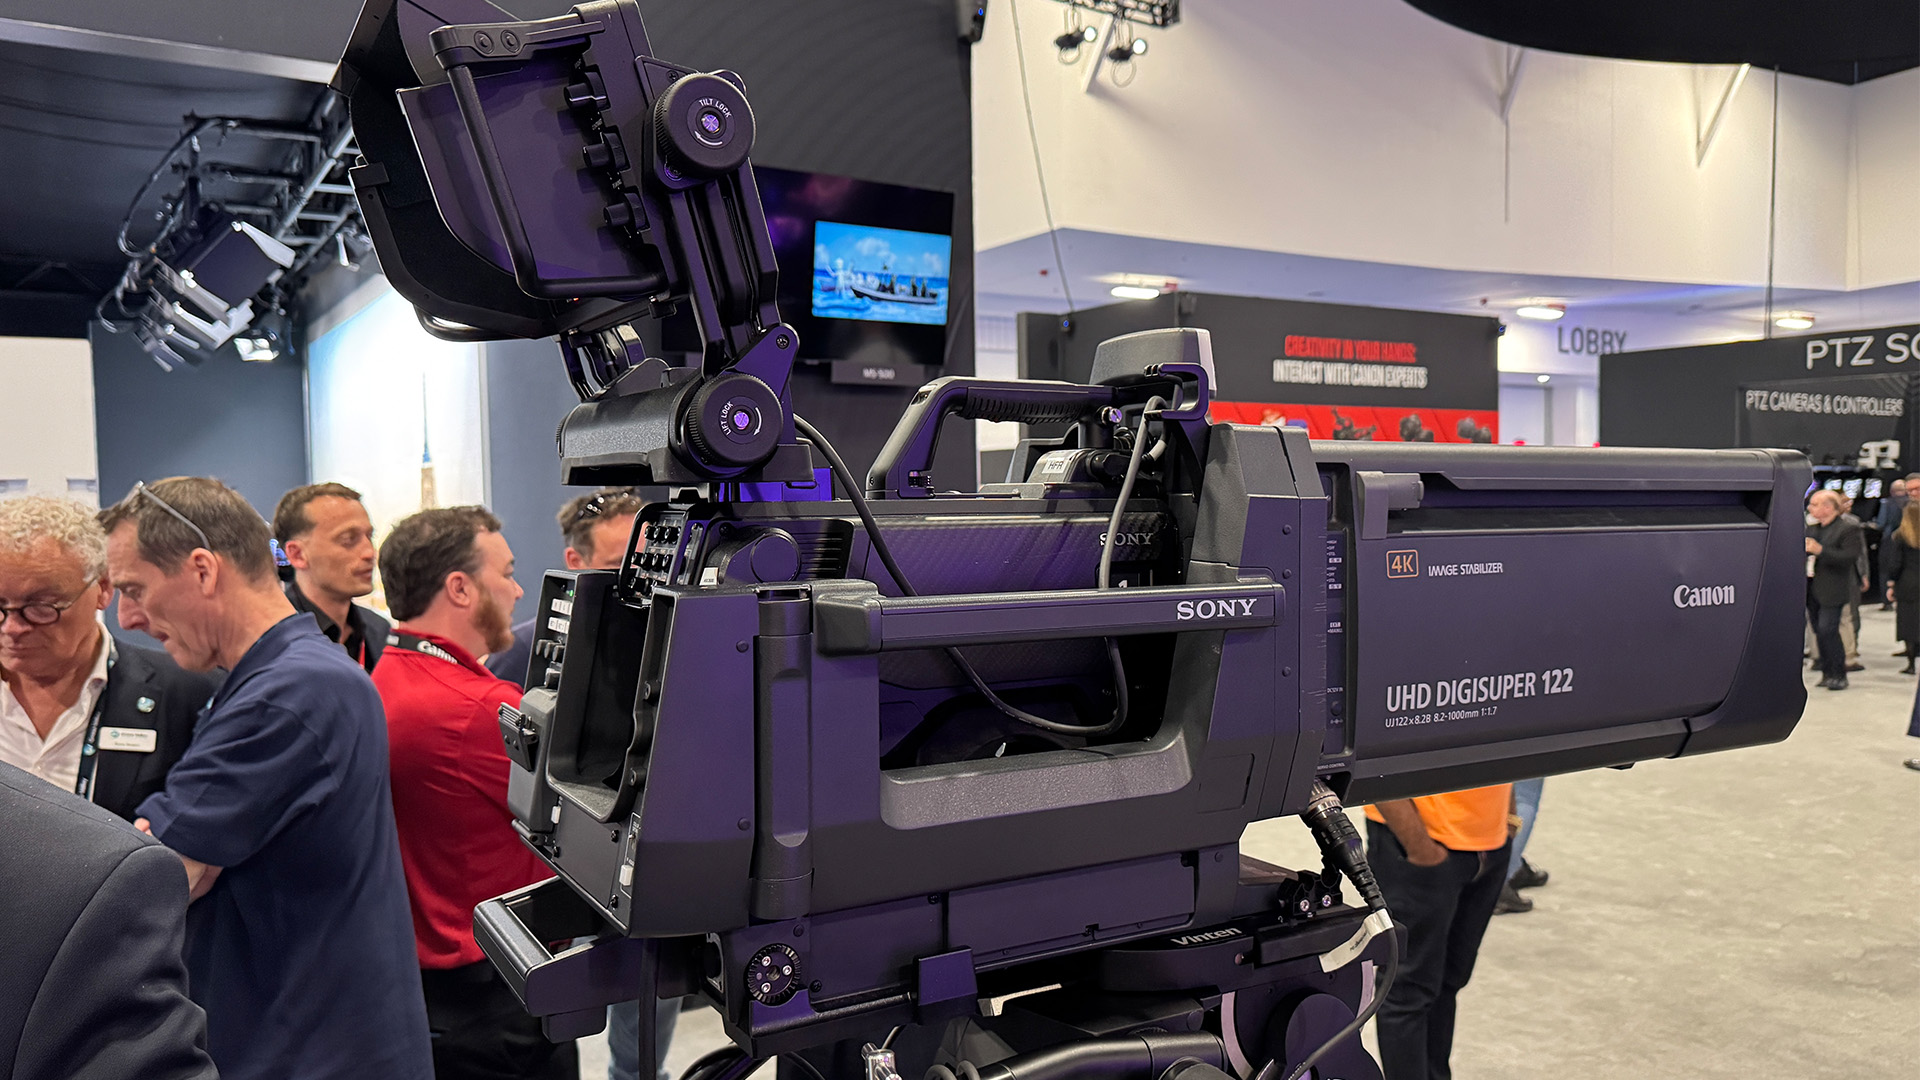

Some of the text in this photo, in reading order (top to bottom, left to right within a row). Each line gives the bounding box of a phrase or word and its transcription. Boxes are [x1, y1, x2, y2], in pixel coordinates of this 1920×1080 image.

[699, 98, 732, 118] TILT LOCK
[1285, 335, 1341, 359] CREATIVITY
[1342, 338, 1354, 359] IN
[1355, 340, 1380, 361] YOUR
[1557, 325, 1627, 354] LOBBY
[1806, 335, 1875, 370] PTZ
[1273, 359, 1428, 389] INTERACT WITH CANON EXPERTS
[1745, 390, 1904, 417] PTZ CAMERAS & CONTROLLERS
[720, 401, 734, 435] LIFT LOCK
[1099, 532, 1154, 546] SONY
[1391, 554, 1414, 573] 4K
[1428, 562, 1503, 577] IMAGE STABILIZER
[1673, 584, 1735, 609] Canon
[1177, 598, 1257, 621] SONY
[1387, 668, 1574, 712] UHD DIGISUPER 122
[1433, 709, 1479, 723] 8.2-1000mm
[1481, 706, 1498, 717] 1:1.7
[1171, 927, 1242, 946] Vinten
